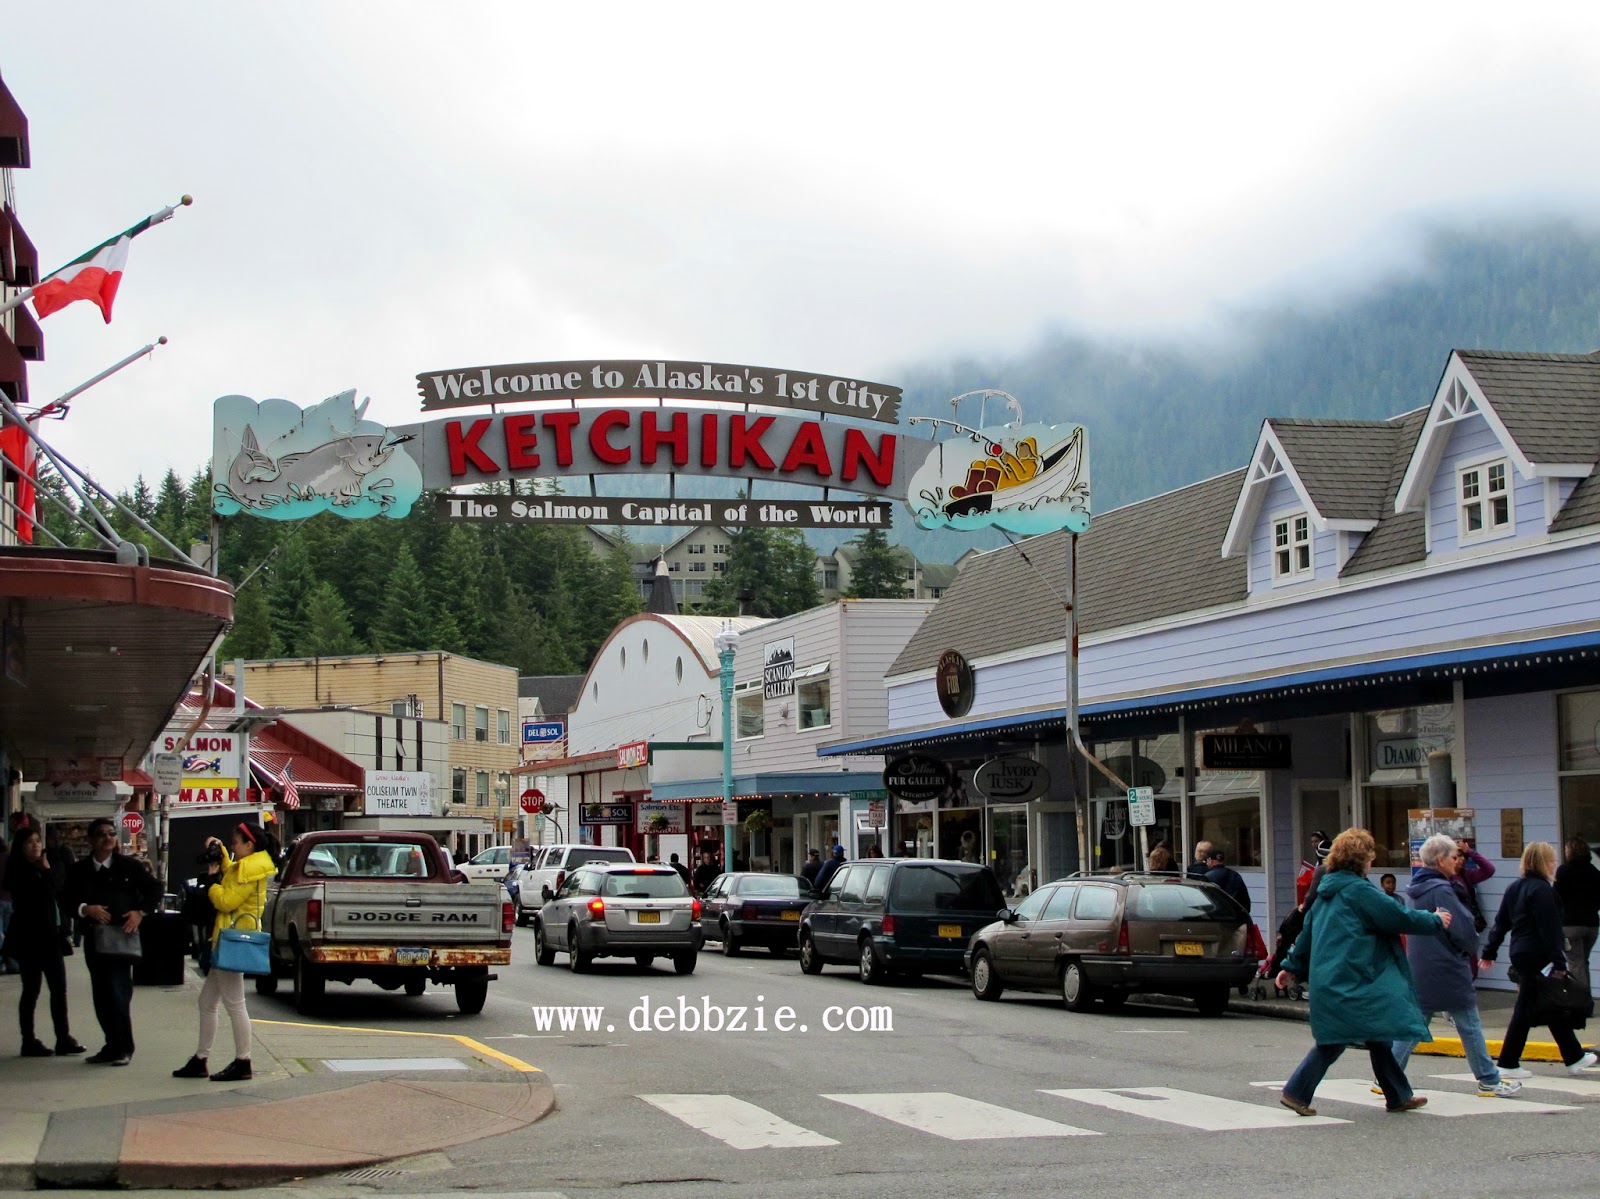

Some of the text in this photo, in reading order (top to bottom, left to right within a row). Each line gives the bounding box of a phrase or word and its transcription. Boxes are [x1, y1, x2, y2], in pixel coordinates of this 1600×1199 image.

[431, 362, 889, 418] Welcome to Alaska's 1st City
[445, 409, 896, 487] KETCHIKAN
[447, 498, 882, 524] The Salmon Capital of the World
[765, 663, 794, 683] SCANLON
[765, 680, 793, 699] GALLERY
[946, 674, 960, 694] FUR
[528, 728, 559, 737] DEL SOL
[1213, 737, 1283, 754] MILANO
[1002, 761, 1041, 777] IVORY
[889, 776, 946, 785] FUR GALLERY
[987, 773, 1025, 789] TUSK
[178, 788, 272, 803] MARKET
[367, 786, 418, 797] COLISEUM TWIN
[1130, 790, 1136, 801] 2
[377, 798, 408, 809] THEATRE
[521, 796, 544, 806] STOP
[612, 808, 628, 816] SOL
[123, 819, 142, 828] STOP
[348, 912, 478, 922] DODGE RAM
